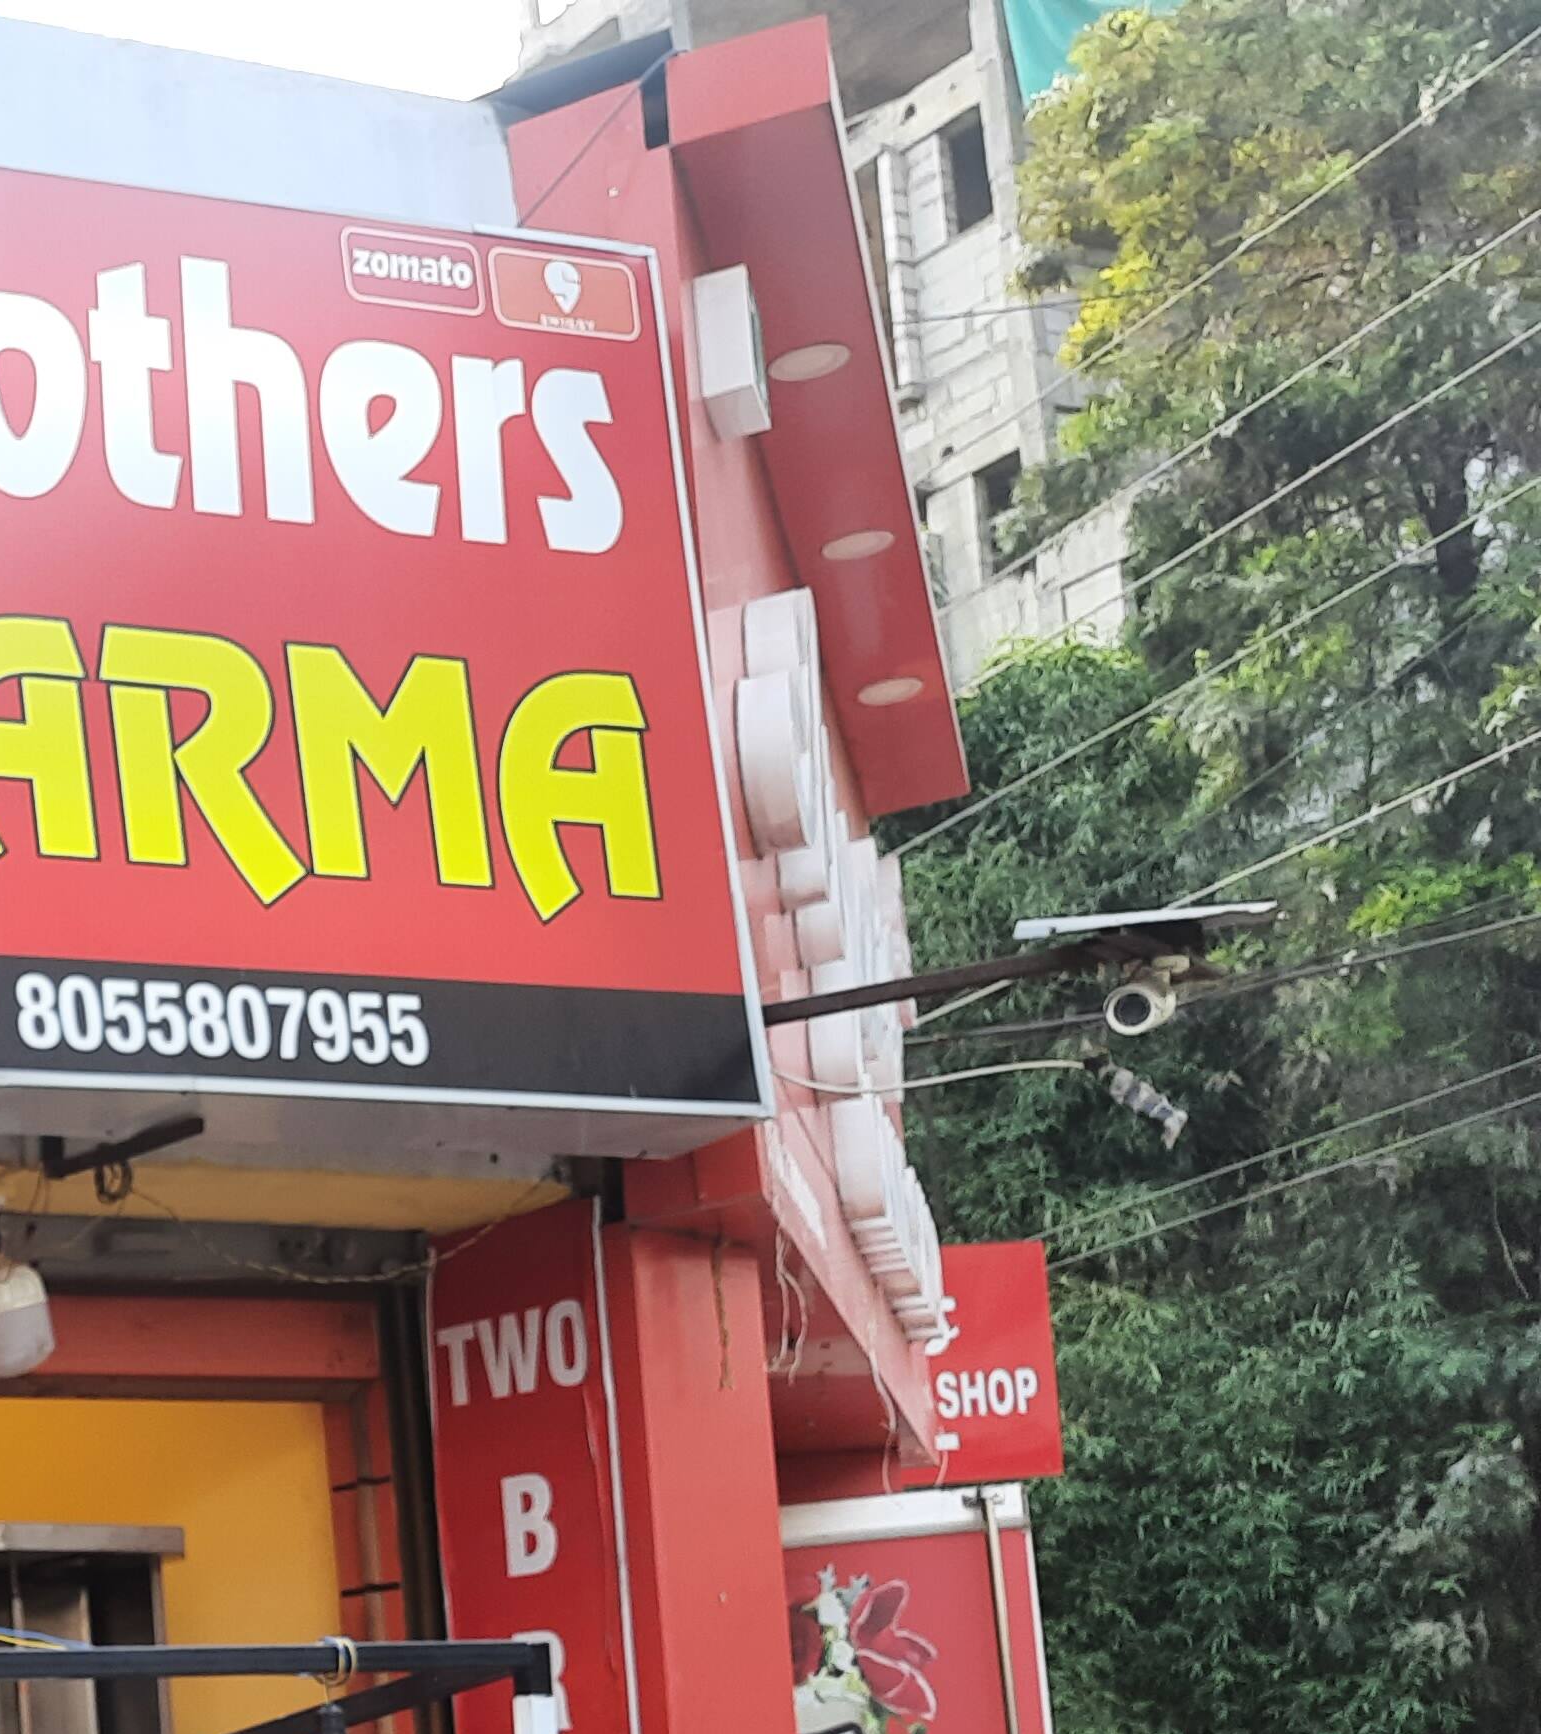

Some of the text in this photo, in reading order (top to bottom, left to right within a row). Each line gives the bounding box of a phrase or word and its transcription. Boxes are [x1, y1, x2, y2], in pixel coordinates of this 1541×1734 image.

[351, 248, 474, 289] zomato
[16, 972, 429, 1066] 8055807955
[436, 1298, 588, 1407] TWO
[936, 1367, 1039, 1420] SHOP
